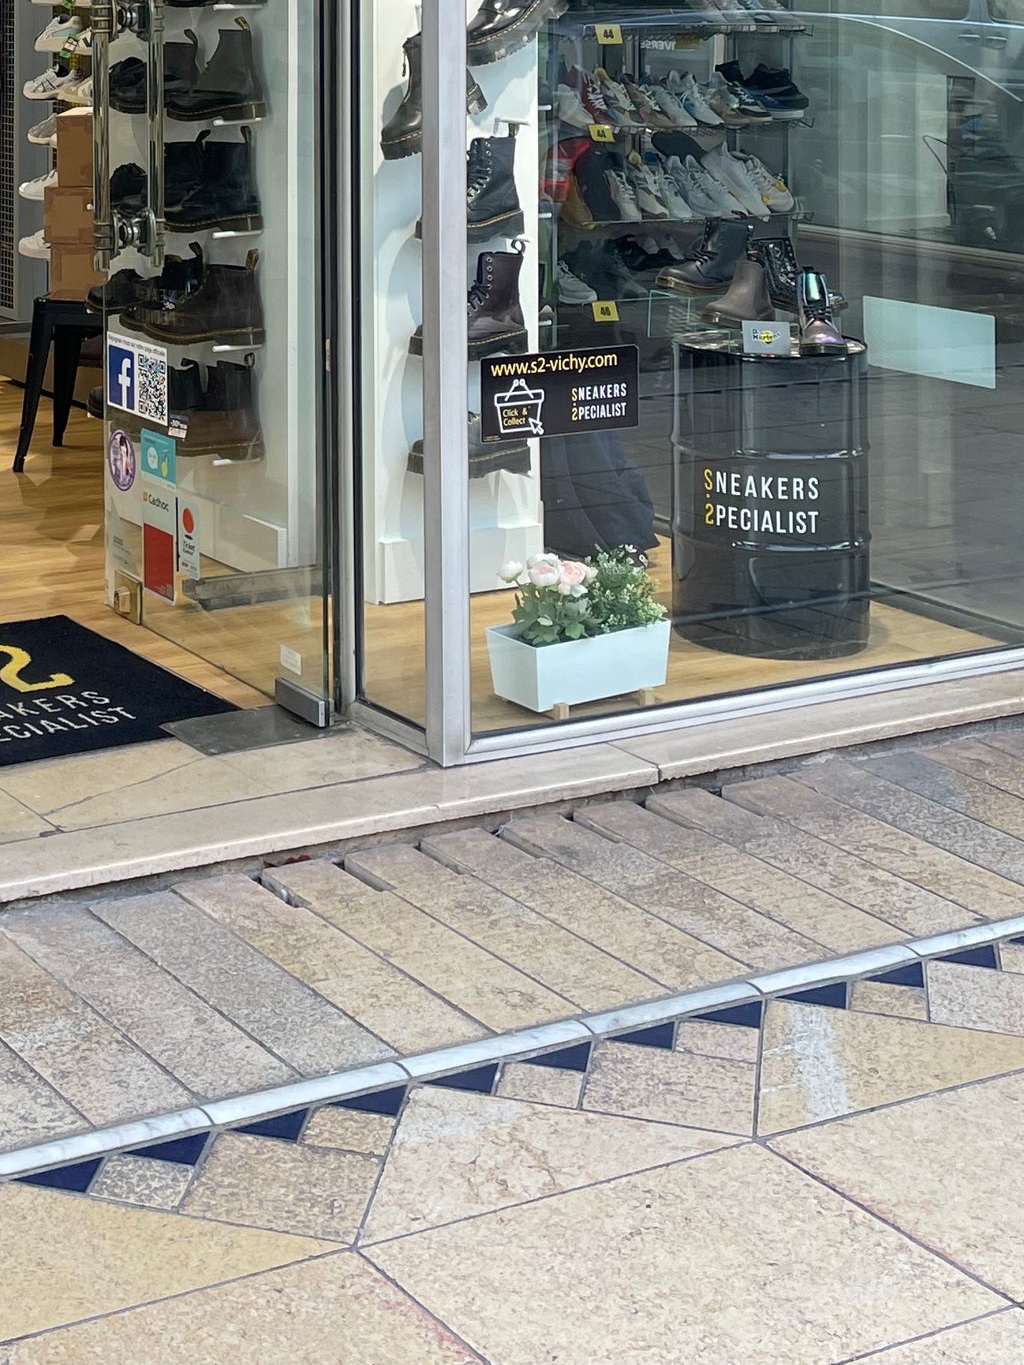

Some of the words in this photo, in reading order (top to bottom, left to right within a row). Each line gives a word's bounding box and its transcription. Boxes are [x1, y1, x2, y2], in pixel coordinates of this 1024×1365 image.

[490, 353, 618, 377] www.s2-vichy.com
[571, 383, 627, 402] SNEAKERS
[502, 408, 519, 418] Click
[521, 407, 528, 416] &
[502, 417, 526, 427] Collect
[704, 468, 819, 500] SNEAKERS
